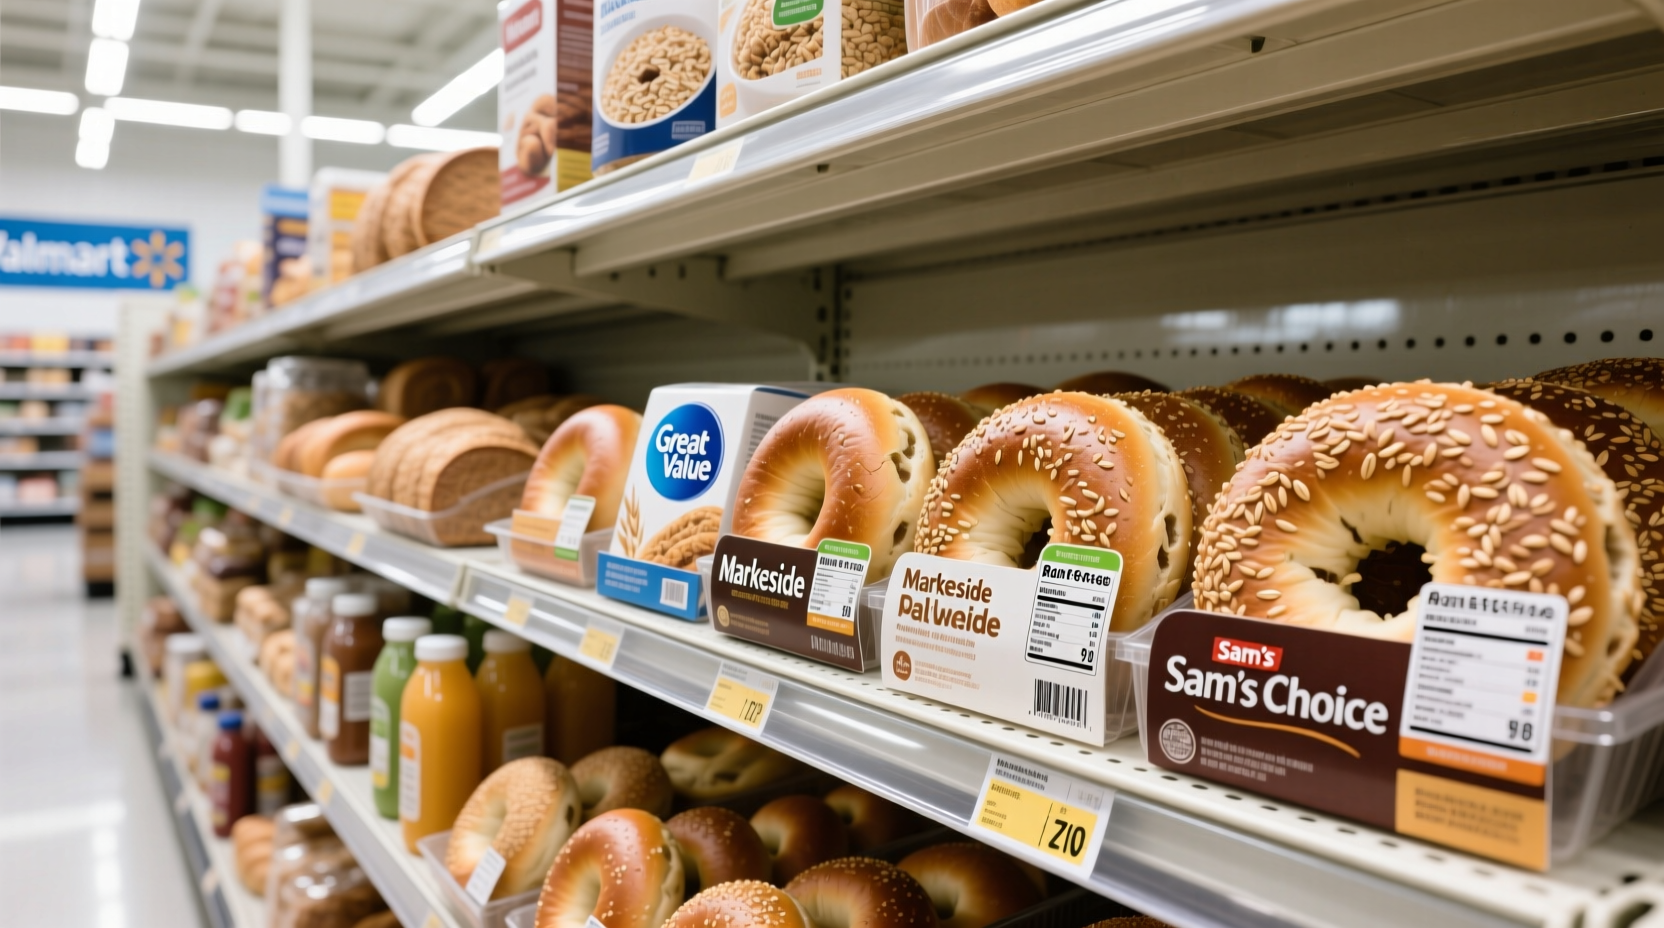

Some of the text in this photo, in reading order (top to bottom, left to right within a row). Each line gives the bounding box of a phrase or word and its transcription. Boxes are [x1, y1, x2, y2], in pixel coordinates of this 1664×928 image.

[655, 423, 710, 456] Great
[663, 452, 712, 481] Value
[718, 553, 805, 599] Markeside
[902, 567, 993, 604] Markeside
[1217, 640, 1276, 668] Sam's
[1164, 655, 1389, 735] Sam's Choice
